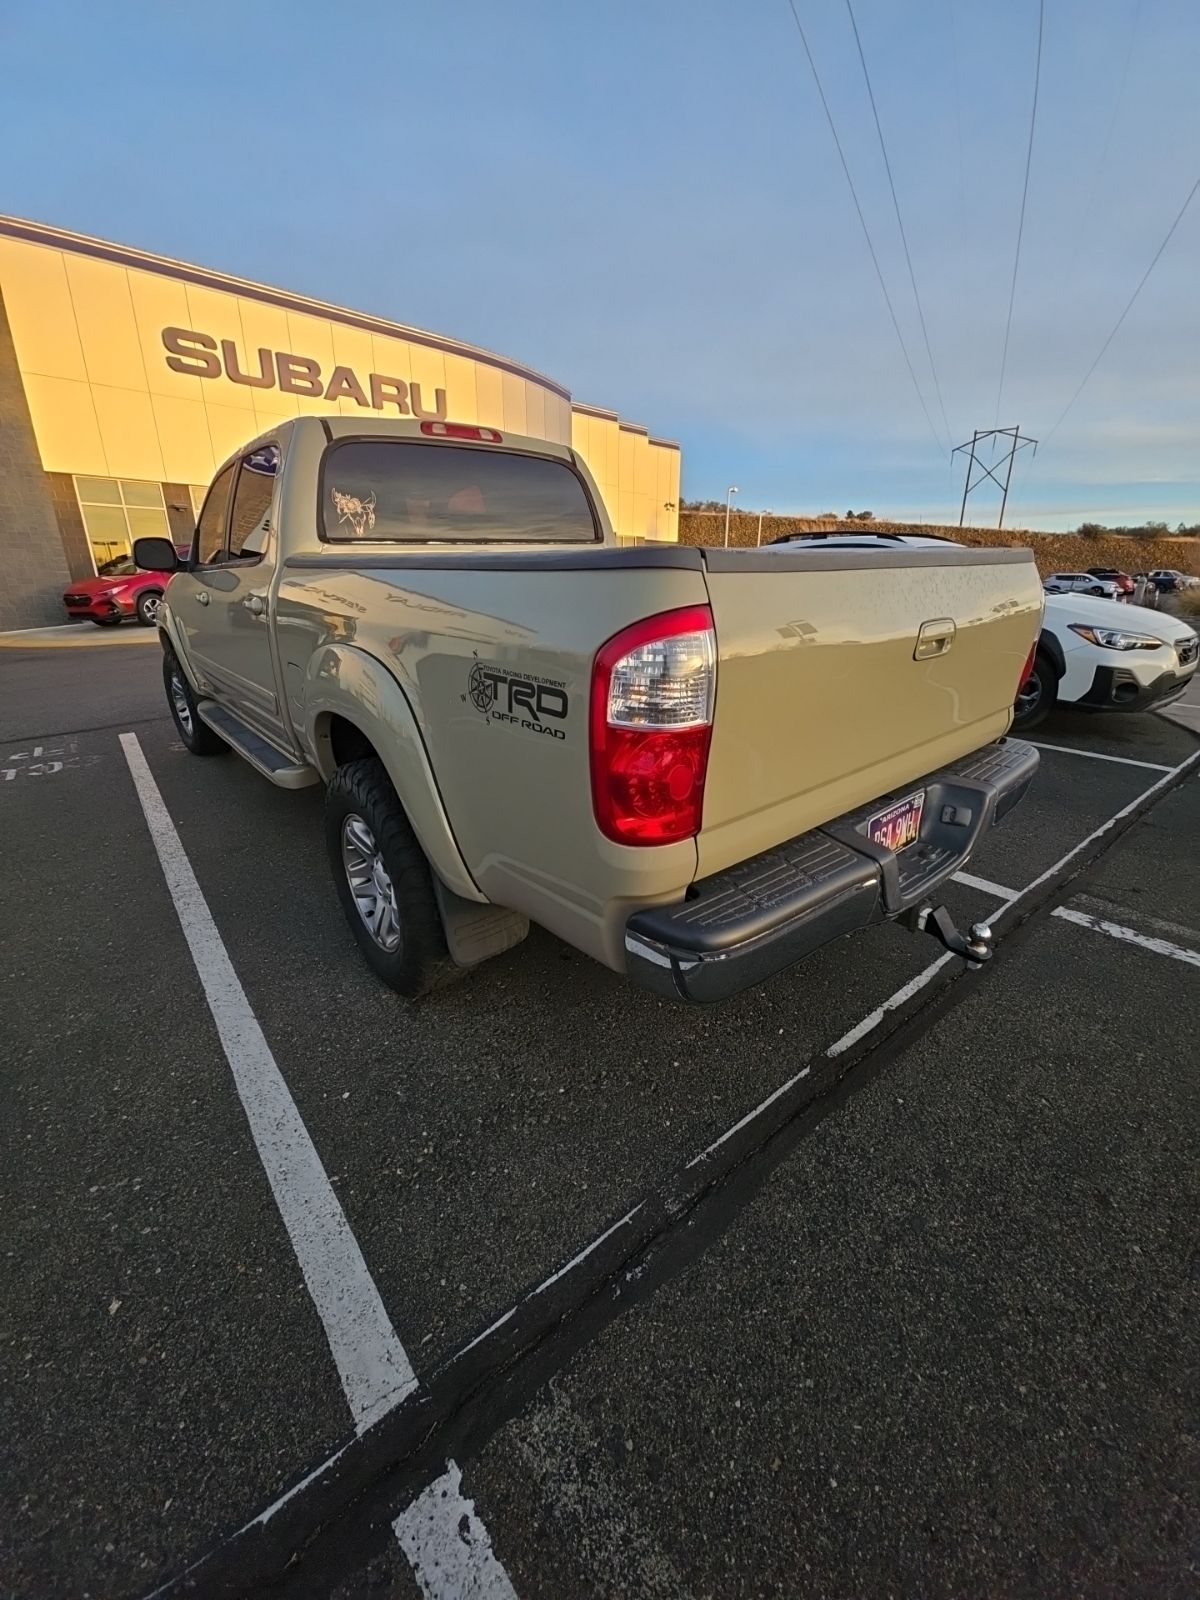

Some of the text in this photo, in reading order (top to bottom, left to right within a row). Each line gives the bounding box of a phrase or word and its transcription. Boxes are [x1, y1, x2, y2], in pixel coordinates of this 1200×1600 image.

[161, 326, 447, 421] SUBARU
[483, 664, 567, 689] TOYOTA RACING DEVELOPMENT
[483, 671, 569, 723] TRD
[491, 710, 566, 740] OFF ROAD
[881, 803, 910, 824] ARIZONA
